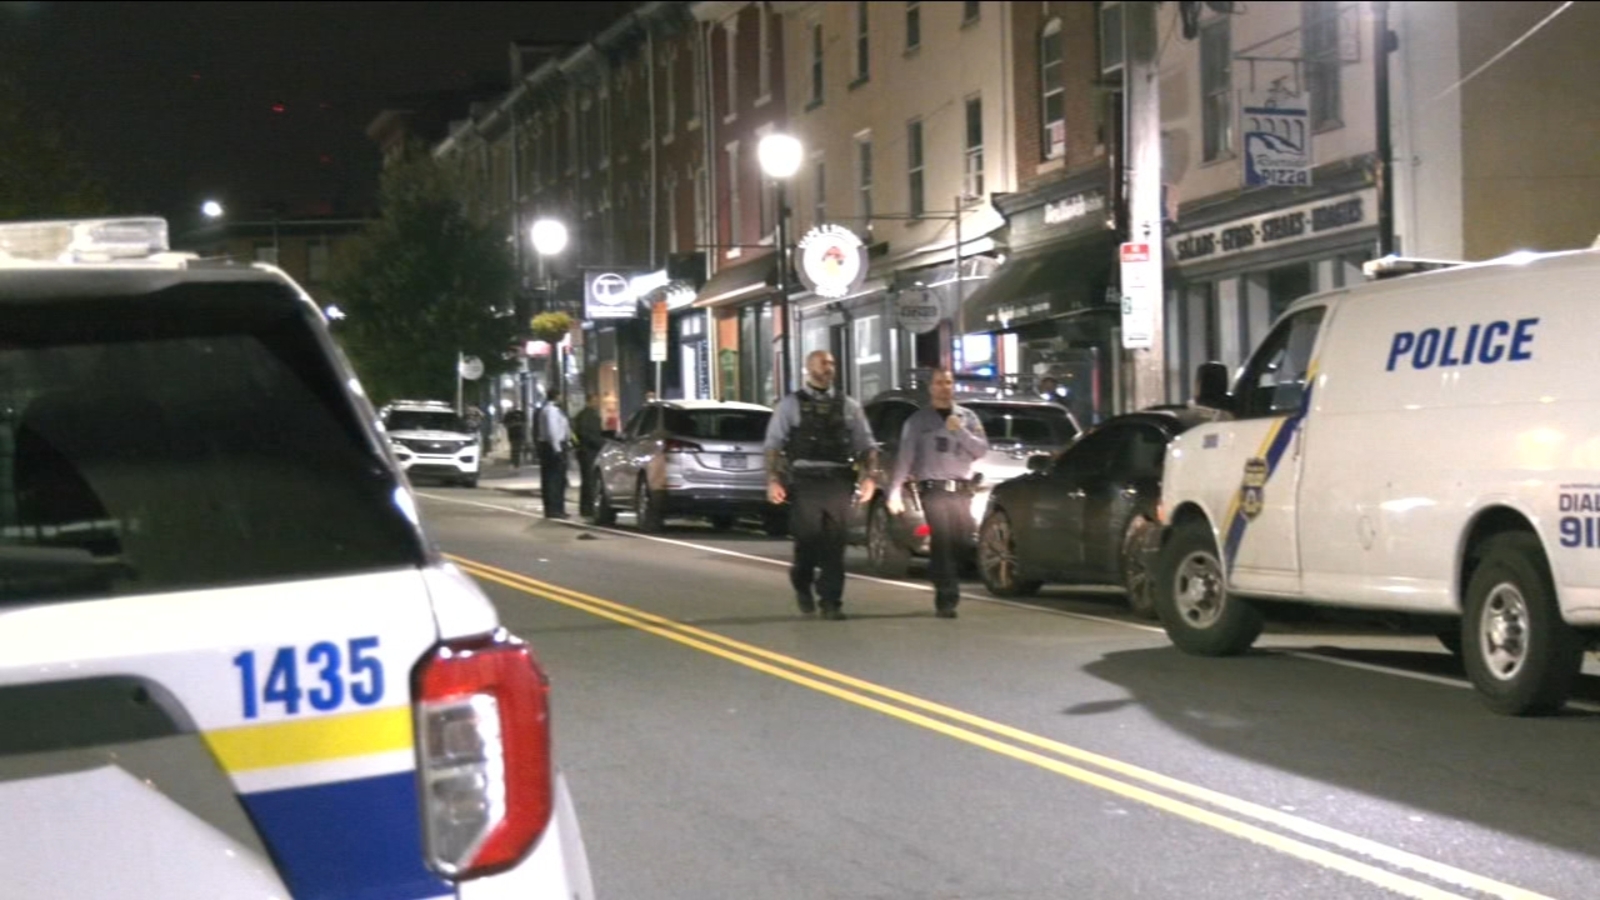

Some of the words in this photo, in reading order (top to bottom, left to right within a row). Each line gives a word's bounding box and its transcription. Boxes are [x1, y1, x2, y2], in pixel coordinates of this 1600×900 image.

[1261, 169, 1307, 184] PIZZA
[1385, 317, 1541, 372] POLICE
[232, 635, 385, 720] 1435
